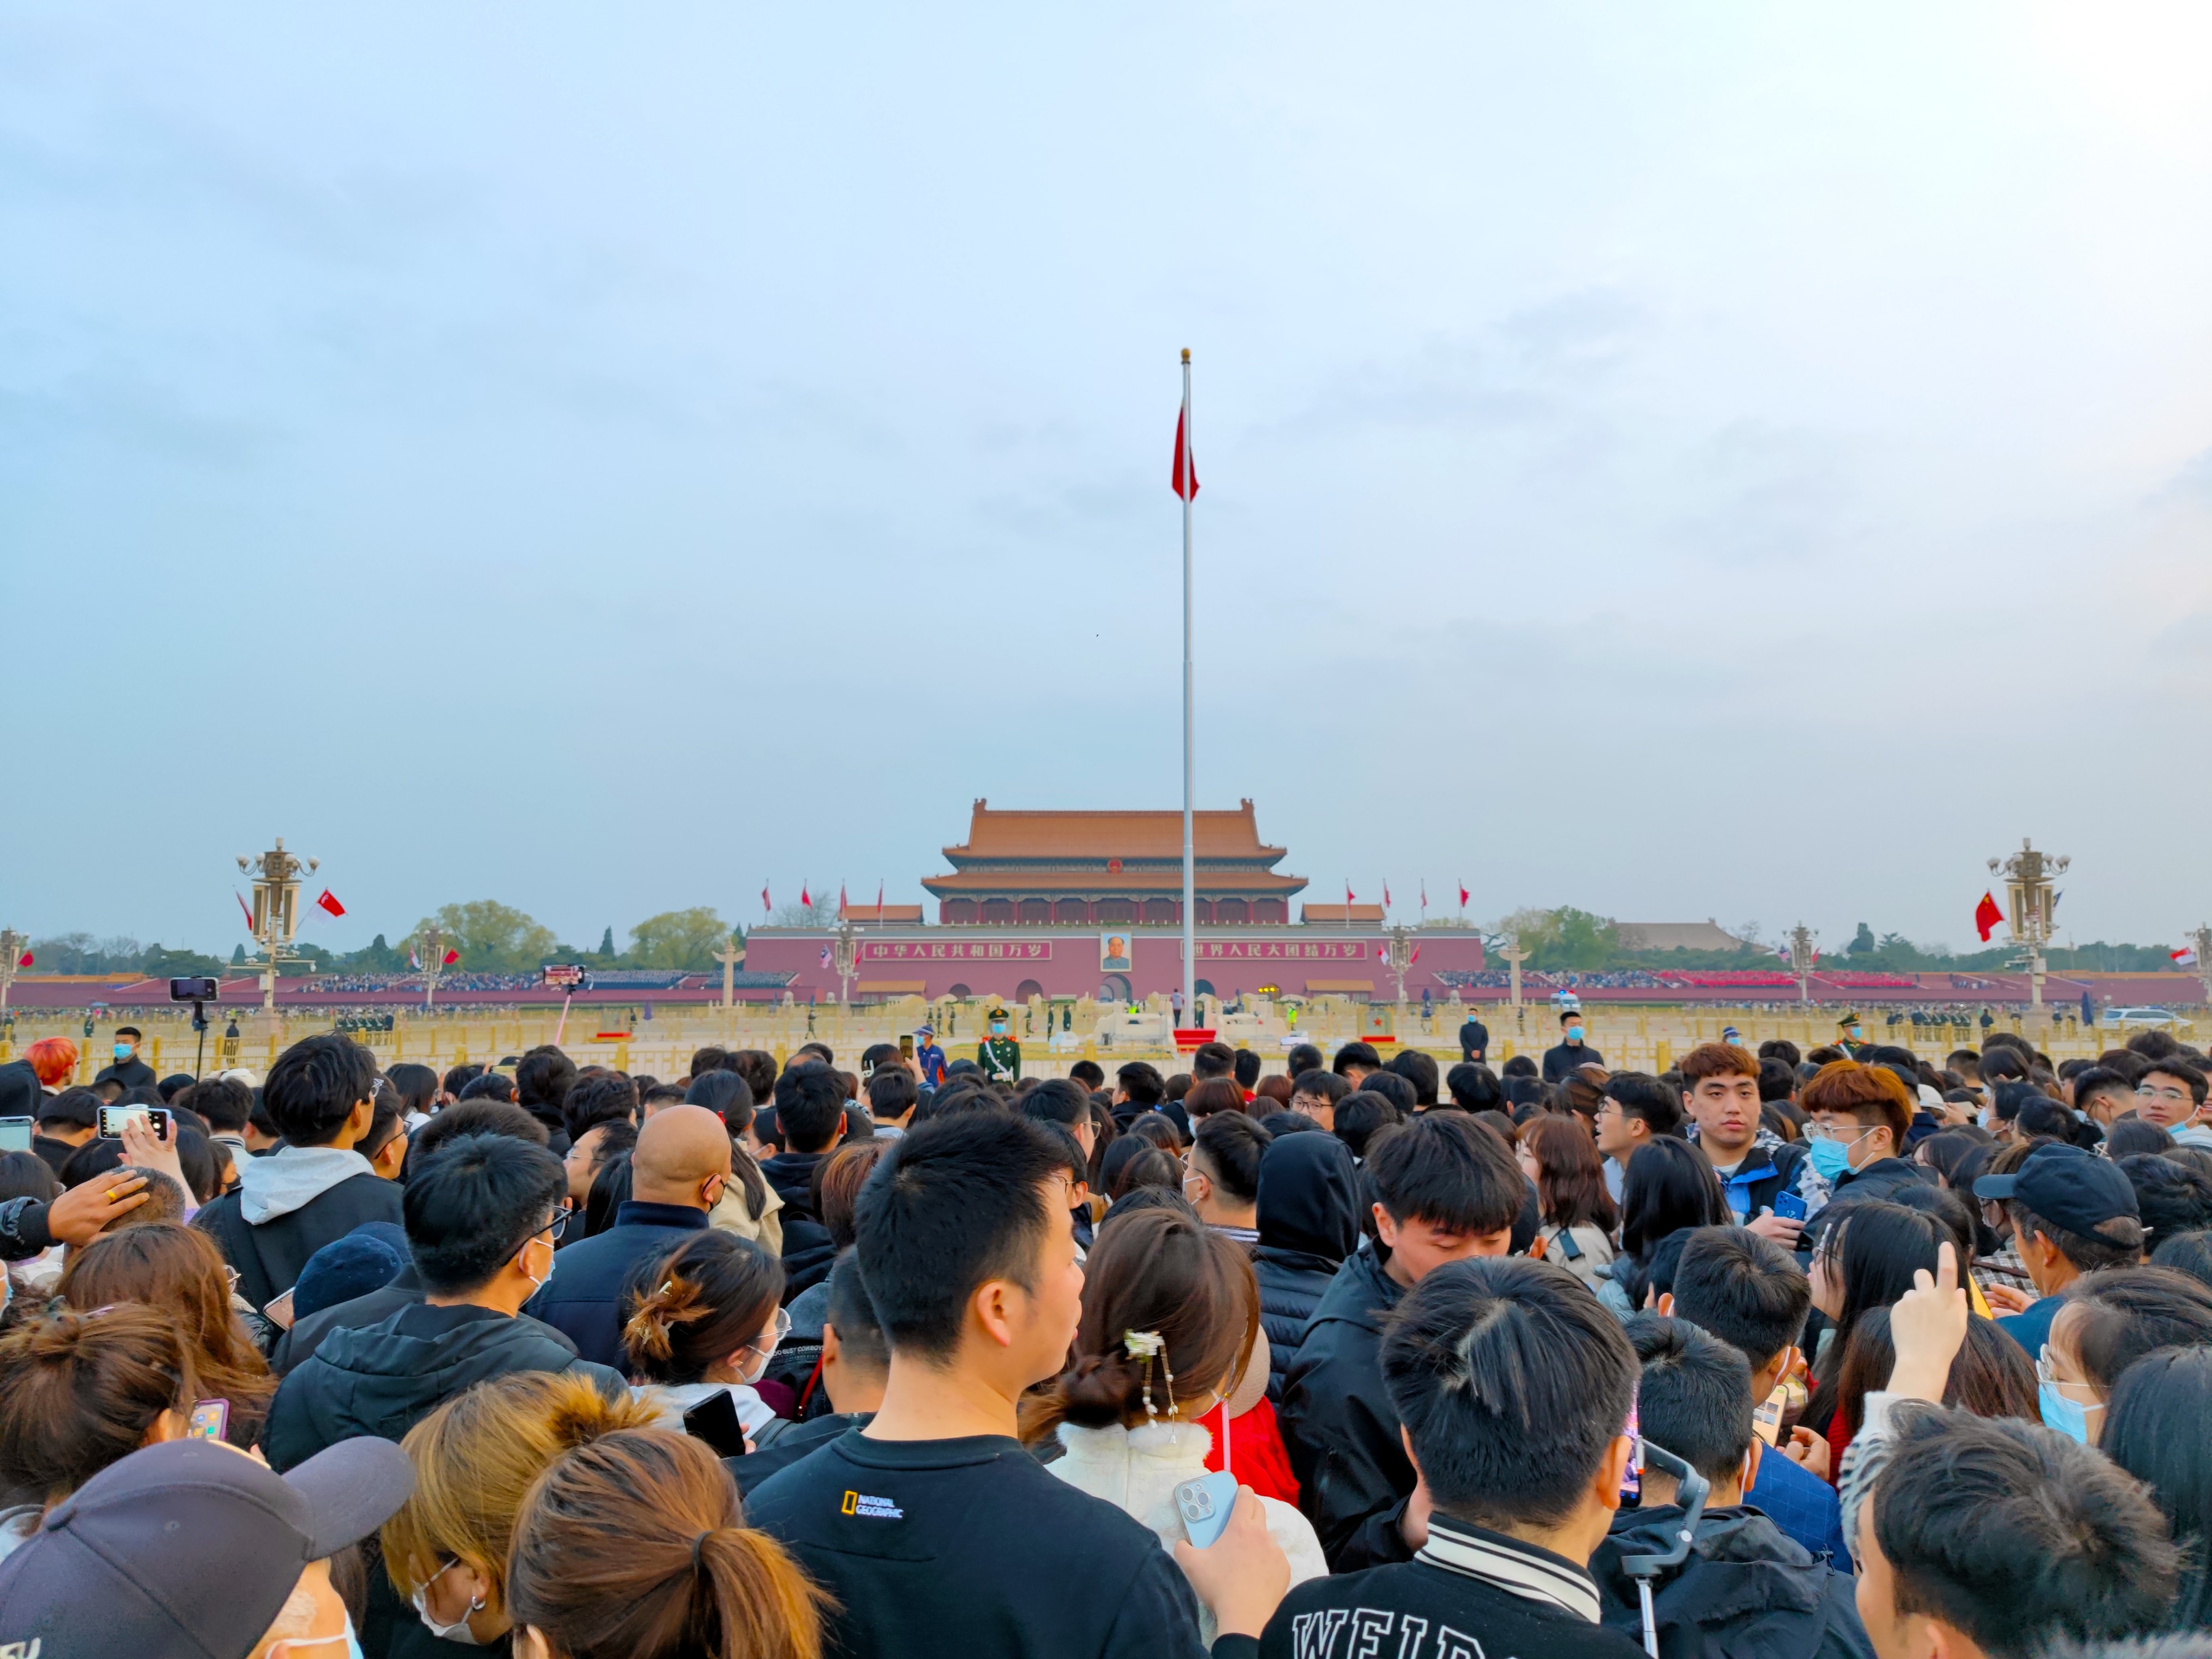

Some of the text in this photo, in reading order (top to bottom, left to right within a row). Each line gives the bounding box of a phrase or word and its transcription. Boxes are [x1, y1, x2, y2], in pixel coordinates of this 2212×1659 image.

[873, 944, 1041, 957] 中华人民共和国万岁
[1194, 943, 1357, 957] 世界人民大团结万岁
[858, 1495, 894, 1508] NATIONAL
[855, 1505, 903, 1518] GEOGRAPHIC
